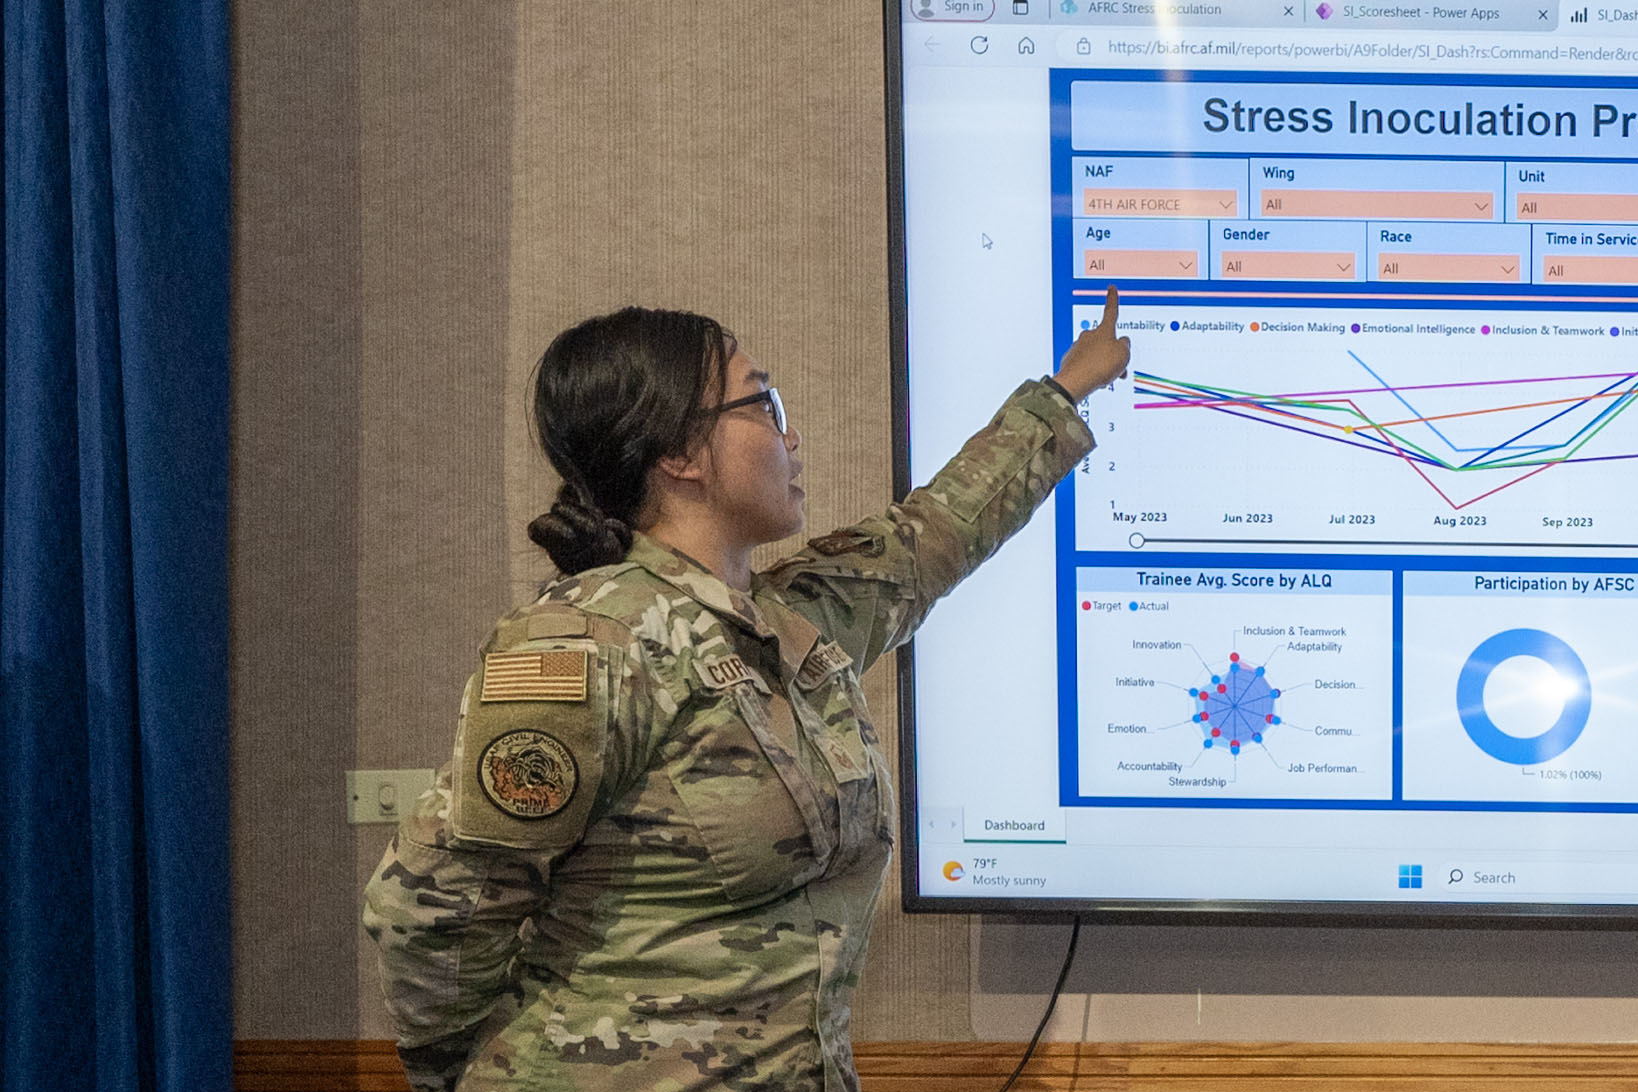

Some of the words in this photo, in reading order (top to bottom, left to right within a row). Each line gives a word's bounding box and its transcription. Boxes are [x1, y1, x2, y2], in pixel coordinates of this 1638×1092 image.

[945, 0, 969, 13] Sign
[973, 3, 983, 11] in
[1089, 2, 1118, 13] AFRC
[1122, 2, 1154, 14] Stress
[1344, 6, 1421, 18] SI_Scoresheet
[1433, 7, 1467, 18] Power
[1471, 8, 1499, 20] Apps
[1204, 98, 1332, 133] Stress
[1350, 101, 1576, 136] Inoculation
[1086, 165, 1113, 177] NAF
[1263, 167, 1294, 181] Wing
[1519, 170, 1544, 182] Unit
[1088, 199, 1112, 210] 4TH
[1115, 199, 1136, 210] AIR
[1139, 199, 1180, 211] FORCE
[1266, 199, 1281, 209] All
[1522, 202, 1536, 213] All
[1086, 227, 1110, 241] Age
[1224, 228, 1270, 240] Gender
[1381, 230, 1412, 242] Race
[1546, 232, 1576, 244] Time
[1582, 233, 1592, 244] in
[1093, 321, 1165, 332] Auntability
[1182, 321, 1244, 333] Adaptability
[1262, 322, 1304, 331] Decision
[1308, 323, 1345, 335] Making
[1114, 512, 1136, 524] May
[1141, 513, 1167, 521] 2023
[1329, 515, 1345, 524] Jul
[1349, 515, 1375, 524] 2023
[1543, 517, 1562, 528] Sep
[1567, 518, 1592, 527] 2023
[1137, 572, 1191, 585] Trainee
[1197, 573, 1227, 589] Avg.
[1232, 573, 1274, 586] Score
[1280, 574, 1296, 589] by
[1301, 574, 1331, 587] ALQ
[1475, 576, 1566, 592] Participation
[1573, 577, 1589, 593] by
[1594, 578, 1634, 591] AFSC
[1093, 601, 1121, 612] Target
[1139, 602, 1168, 610] Actual
[1133, 640, 1181, 649] Innovation
[1287, 642, 1342, 653] Adaptability
[1116, 678, 1154, 687] Initiative
[1117, 761, 1182, 773] Accountability
[1169, 777, 1226, 788] Stewardship
[985, 820, 1044, 830] Dashboard
[974, 858, 996, 868] 79°F
[973, 875, 1010, 887] Mostly
[1014, 878, 1046, 888] sunny
[1474, 872, 1515, 883] Search
